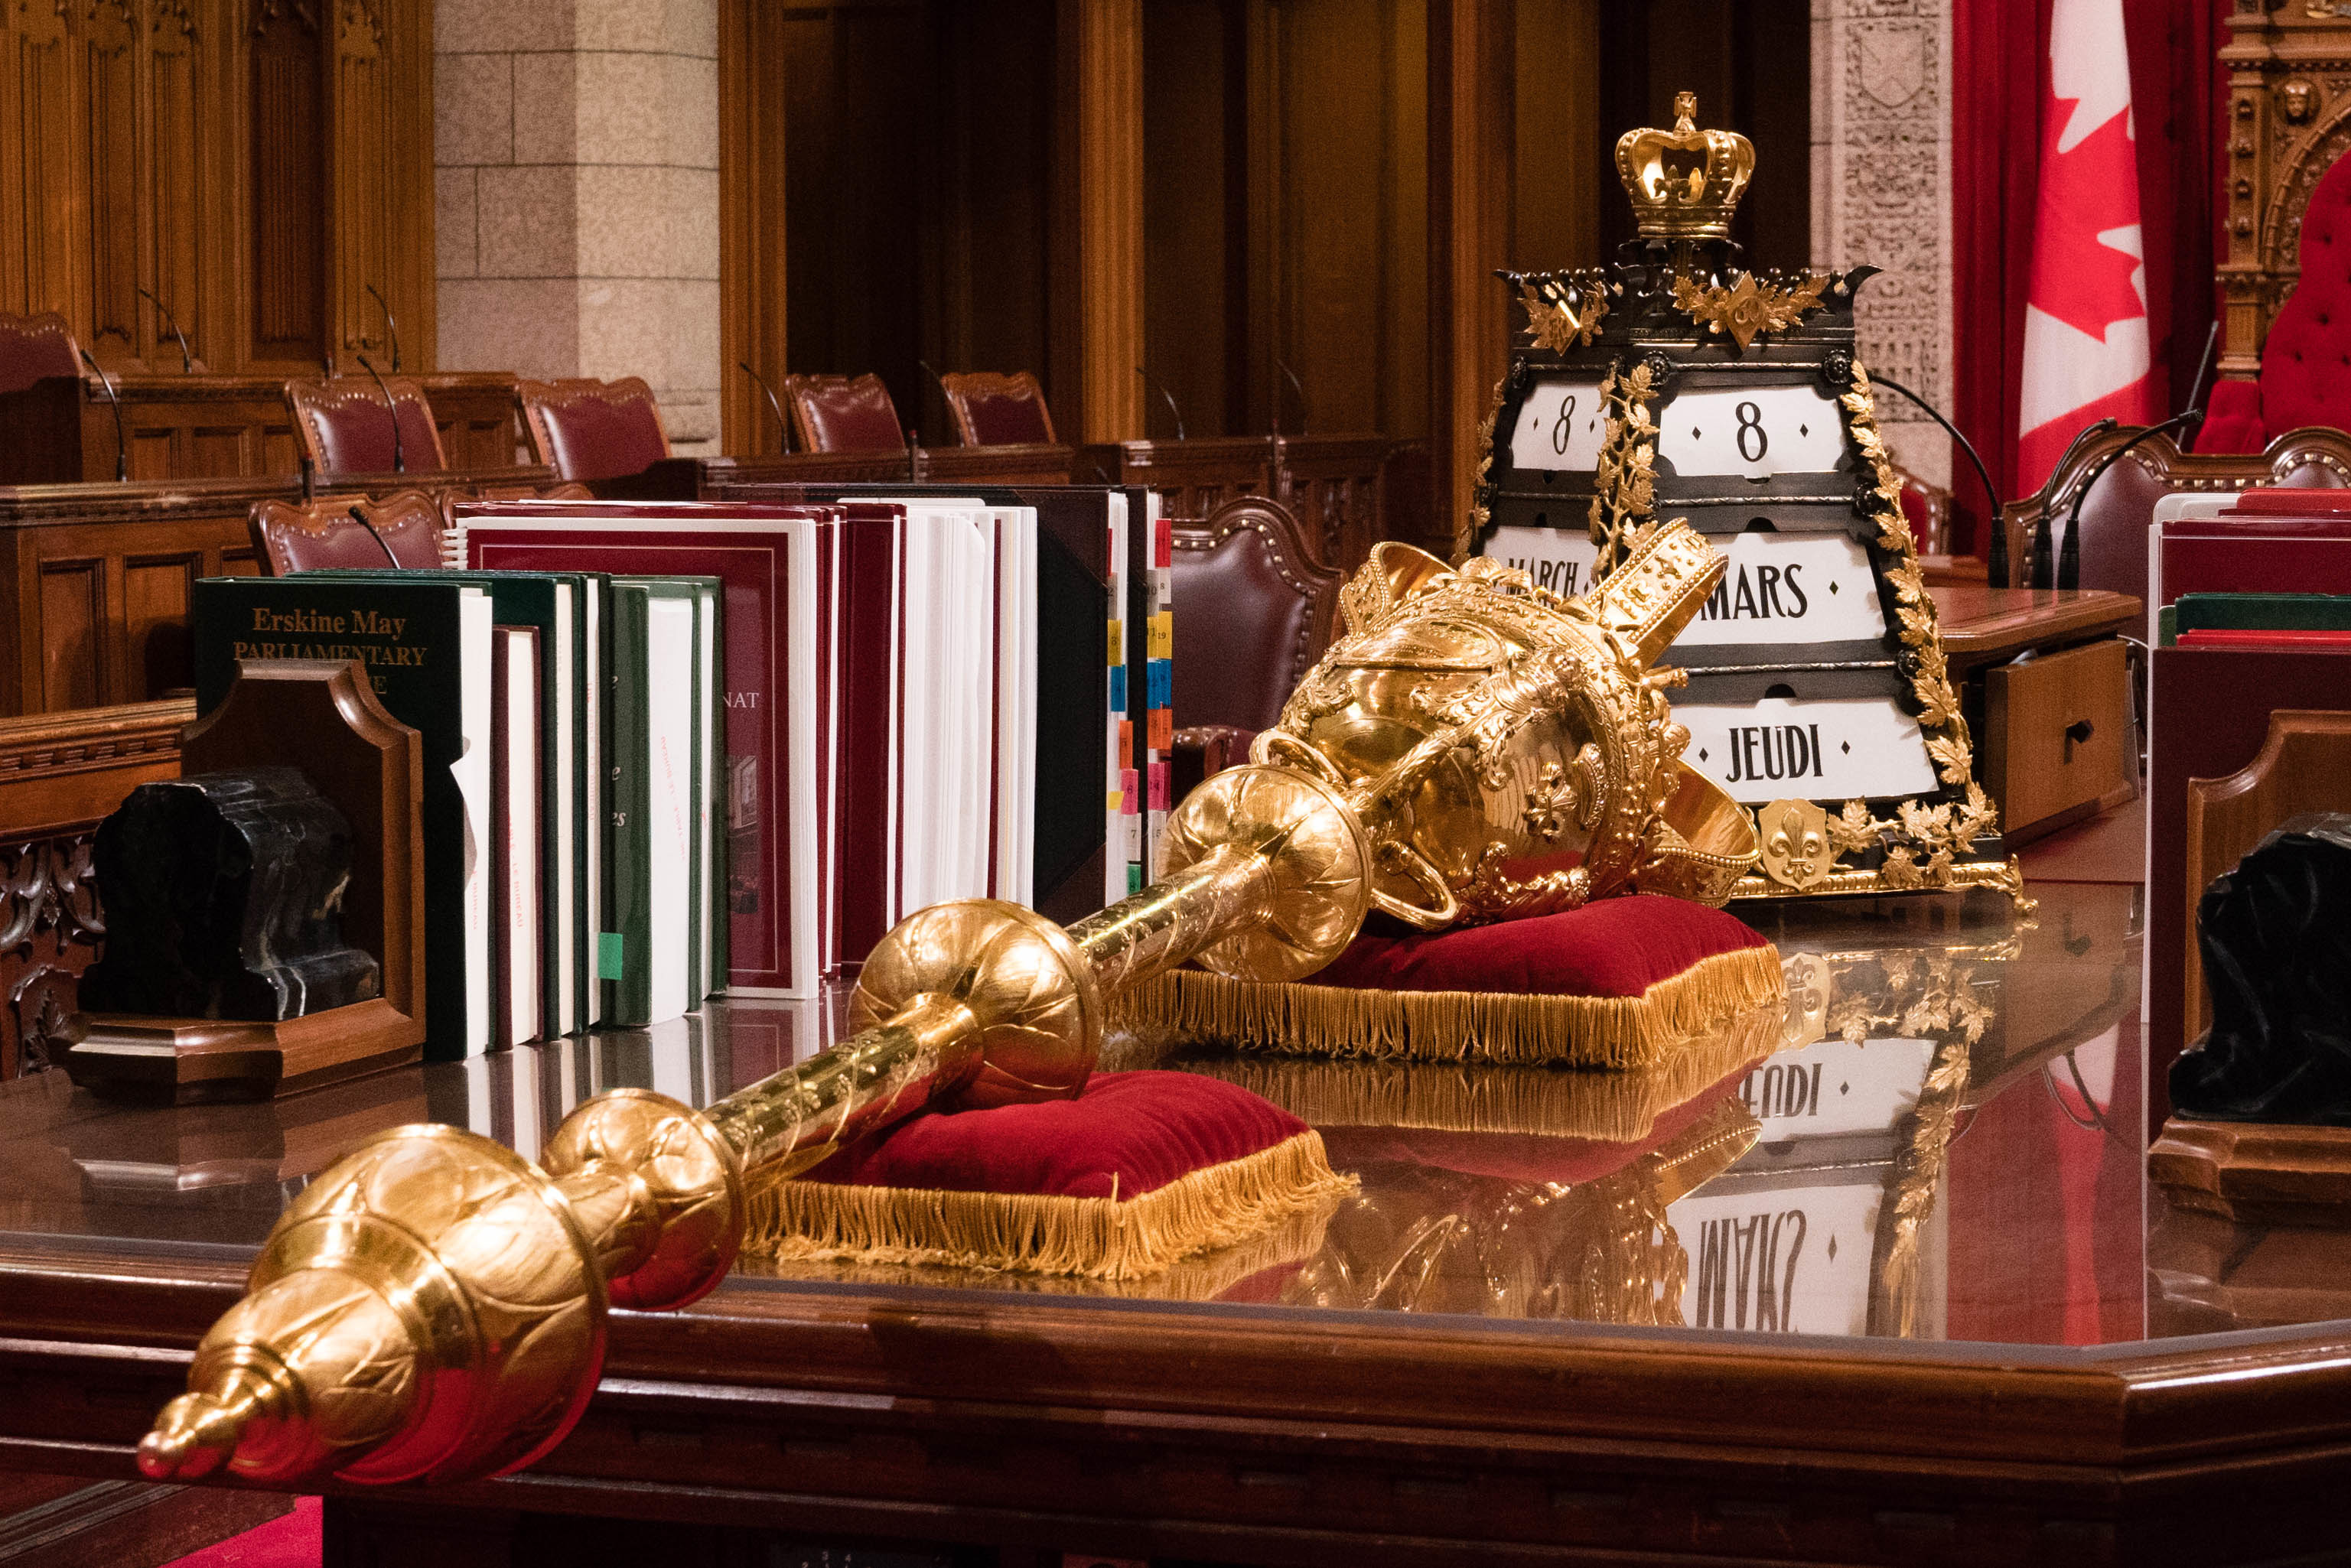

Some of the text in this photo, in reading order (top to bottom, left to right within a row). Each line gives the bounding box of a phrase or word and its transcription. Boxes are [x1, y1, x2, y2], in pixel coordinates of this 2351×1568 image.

[1552, 395, 1576, 456] 8
[1734, 401, 1768, 463] 8
[1700, 563, 1808, 621] MARS
[252, 607, 407, 641] Erskine May
[1111, 636, 1118, 646] 3
[1158, 631, 1167, 640] 19
[233, 640, 429, 666] PARLIAMENTARY
[1725, 724, 1824, 782] JEUDI
[1131, 828, 1137, 838] 7
